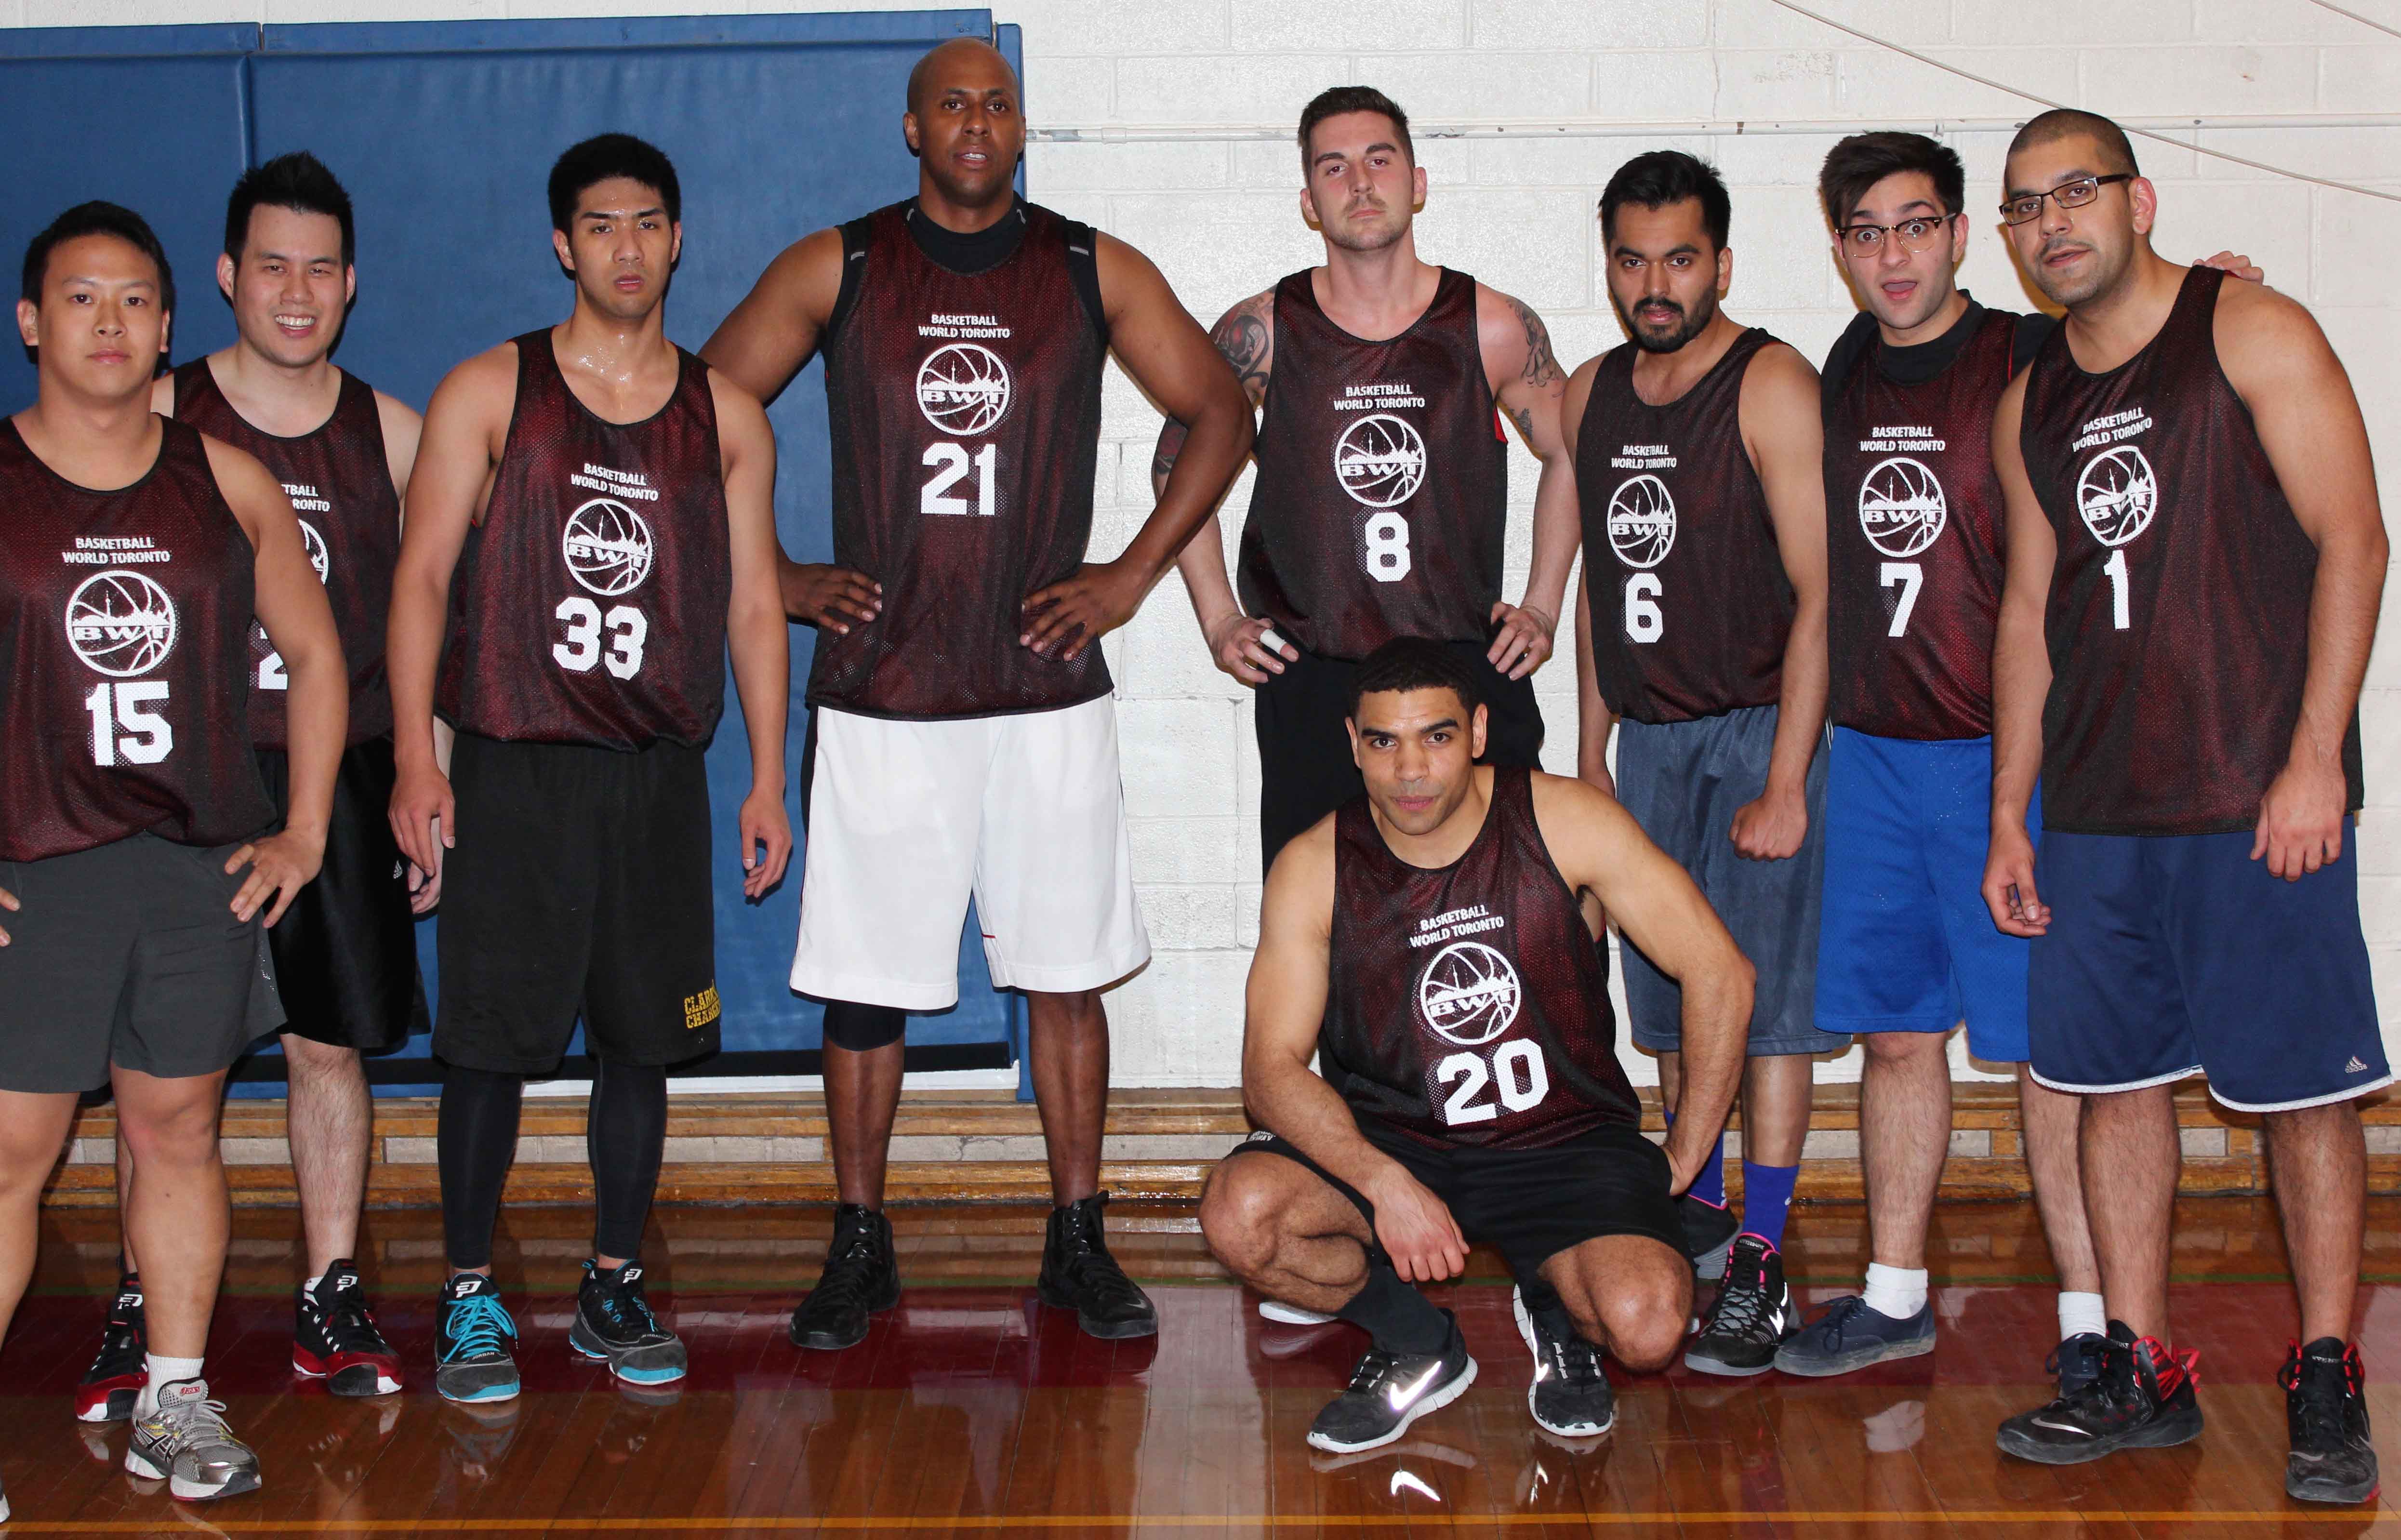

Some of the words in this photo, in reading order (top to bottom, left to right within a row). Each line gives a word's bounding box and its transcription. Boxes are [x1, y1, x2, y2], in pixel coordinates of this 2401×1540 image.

[931, 314, 998, 326] BASKETBALL
[918, 326, 959, 338] WORLD
[959, 328, 1010, 339] TORONTO
[922, 390, 1005, 404] BWT
[1346, 384, 1413, 398] BASKETBALL
[1334, 398, 1373, 411] WORLD
[1374, 397, 1425, 409] TORONTO
[2083, 407, 2144, 434] BASKETBALL
[1872, 426, 1934, 438] BASKETBALL
[2072, 432, 2110, 452] WORLD
[2112, 417, 2152, 441] TORONTO
[1622, 445, 1669, 456] BASKETBALL
[1860, 440, 1896, 451] WORLD
[1897, 440, 1946, 451] TORONTO
[1341, 464, 1422, 477] BWT
[1611, 458, 1644, 469] WORLD
[1645, 457, 1677, 469] TORONTO
[584, 463, 647, 486] BASKETBALL
[921, 442, 996, 516] 21
[281, 484, 318, 497] TBALL
[571, 474, 607, 491] WORLD
[608, 483, 659, 502] TORONTO
[292, 498, 331, 512] RONTO
[1864, 510, 1942, 523] BWT
[1611, 524, 1672, 536] BWT
[75, 537, 155, 550] BASKETBALL
[1365, 512, 1411, 582] 8
[62, 552, 108, 564] WORLD
[111, 550, 170, 564] TORONTO
[568, 543, 647, 568] BWT
[2103, 549, 2130, 629] 1
[1881, 562, 1923, 637] 7
[1625, 573, 1663, 643] 6
[74, 626, 170, 641] BWT
[553, 596, 648, 680] 33
[85, 680, 173, 766] 15
[1420, 904, 1489, 931] BASKETBALL
[1409, 929, 1450, 948] WORLD
[1451, 916, 1504, 937] TORONTO
[1428, 987, 1515, 1017] BWT
[1436, 1036, 1549, 1126] 20
